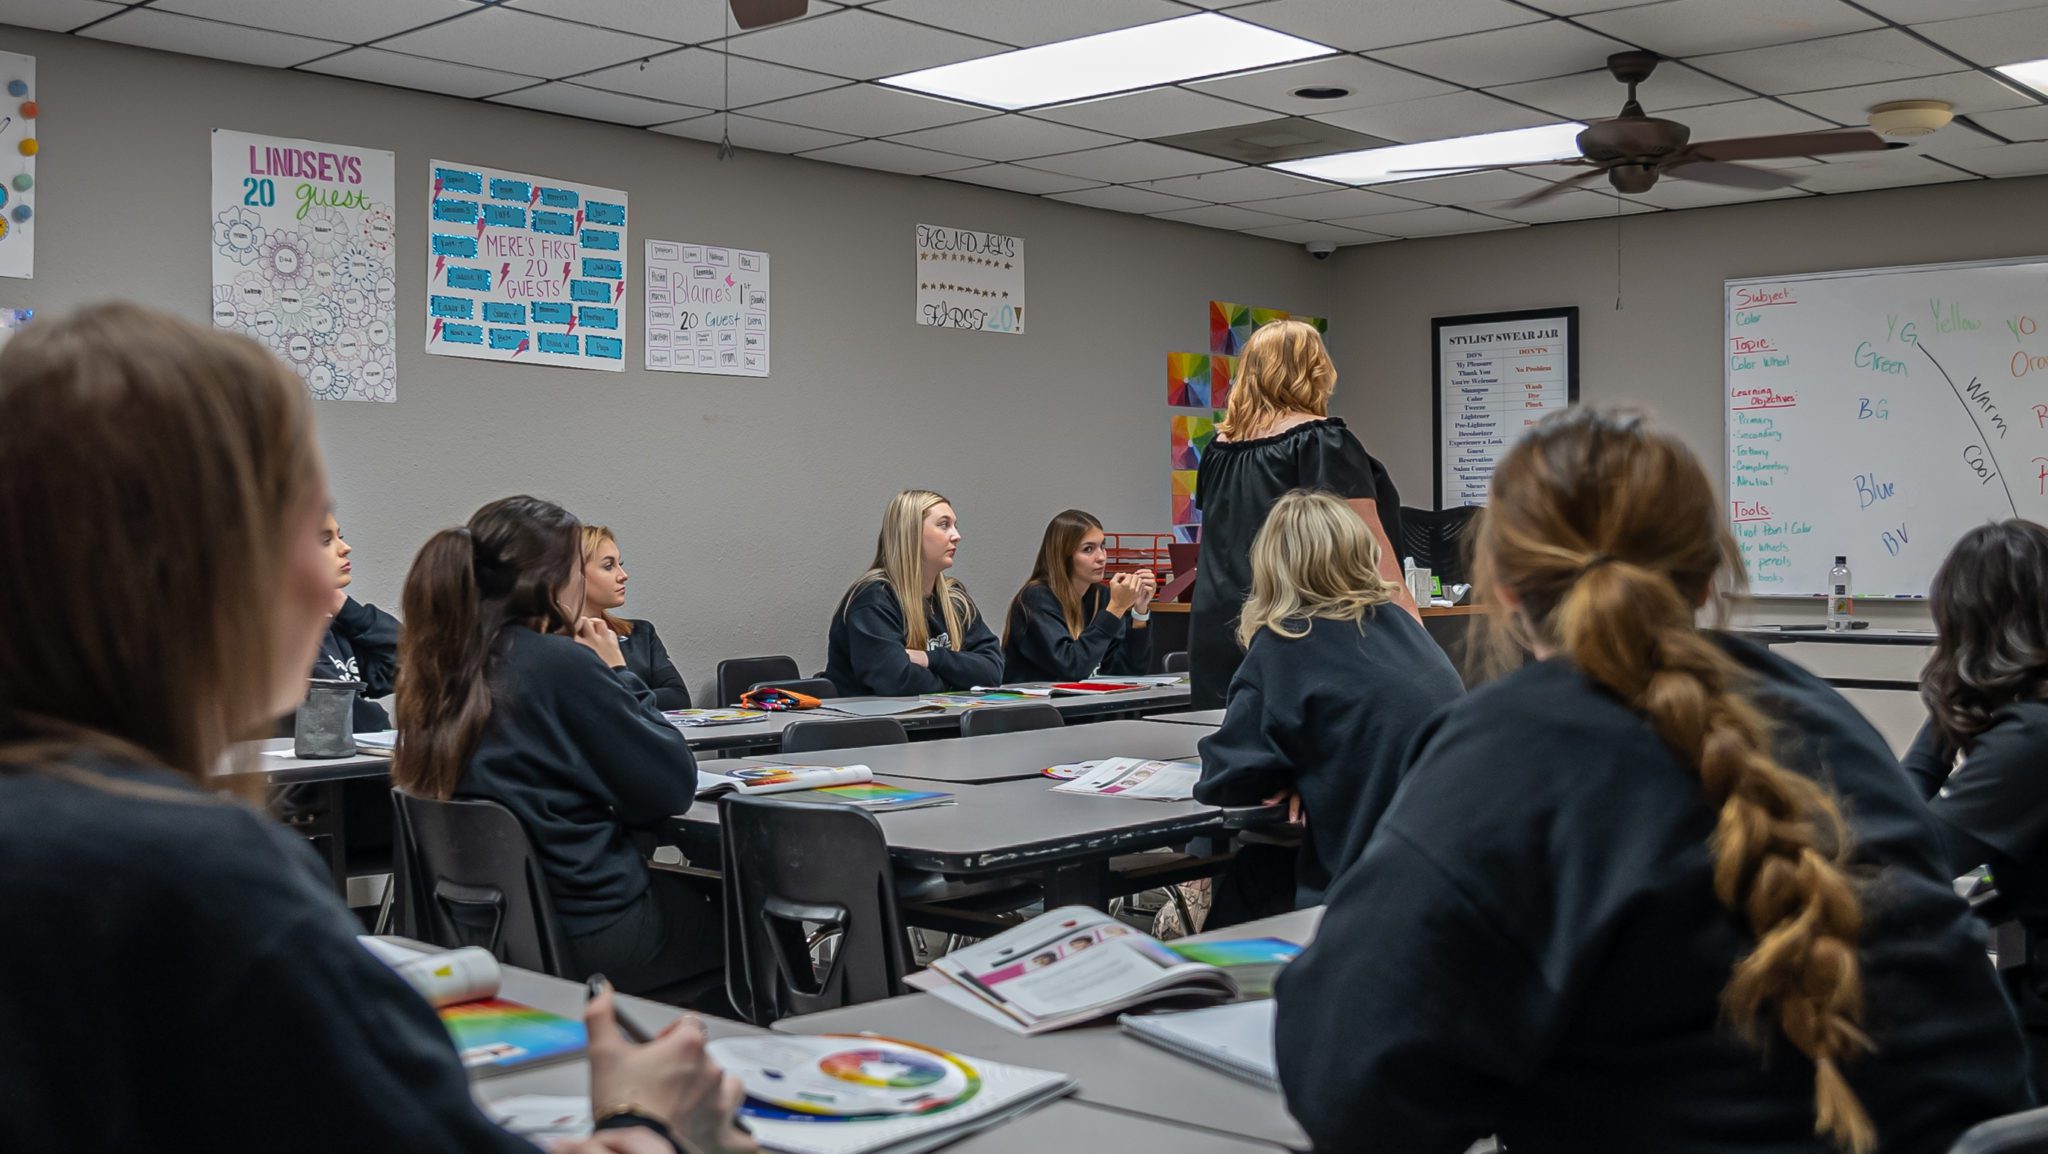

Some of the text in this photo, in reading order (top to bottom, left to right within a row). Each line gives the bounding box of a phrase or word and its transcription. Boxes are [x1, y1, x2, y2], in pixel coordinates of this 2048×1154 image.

[249, 145, 362, 184] LINDSEYS
[243, 177, 372, 220] 20 guest
[486, 234, 578, 261] MERE'S FIRST
[916, 225, 1015, 258] KENDAL'S
[524, 258, 549, 278] 20
[506, 280, 561, 300] GUESTS
[672, 271, 732, 307] Blaine's
[679, 311, 699, 331] 20
[705, 312, 741, 328] Guest
[923, 300, 988, 331] FIRST
[1736, 312, 1761, 326] Color
[1929, 297, 1983, 335] Yellow
[1448, 329, 1559, 345] STYLIST SWEAR JAR
[1456, 361, 1465, 369] My
[1525, 365, 1552, 373] Problem
[1731, 356, 1756, 371] Color
[1854, 341, 1909, 377] Green
[1458, 369, 1478, 377] Thank
[1731, 387, 1773, 399] Learning
[1454, 422, 1496, 430] Pre-Lightener
[1460, 413, 1490, 421] Lightener
[1738, 412, 1774, 430] Primary
[1448, 440, 1481, 448] Experience
[1963, 445, 1996, 485] Cool
[1853, 473, 1896, 511] Blue
[1791, 521, 1813, 535] Color
[1881, 522, 1909, 557] BV
